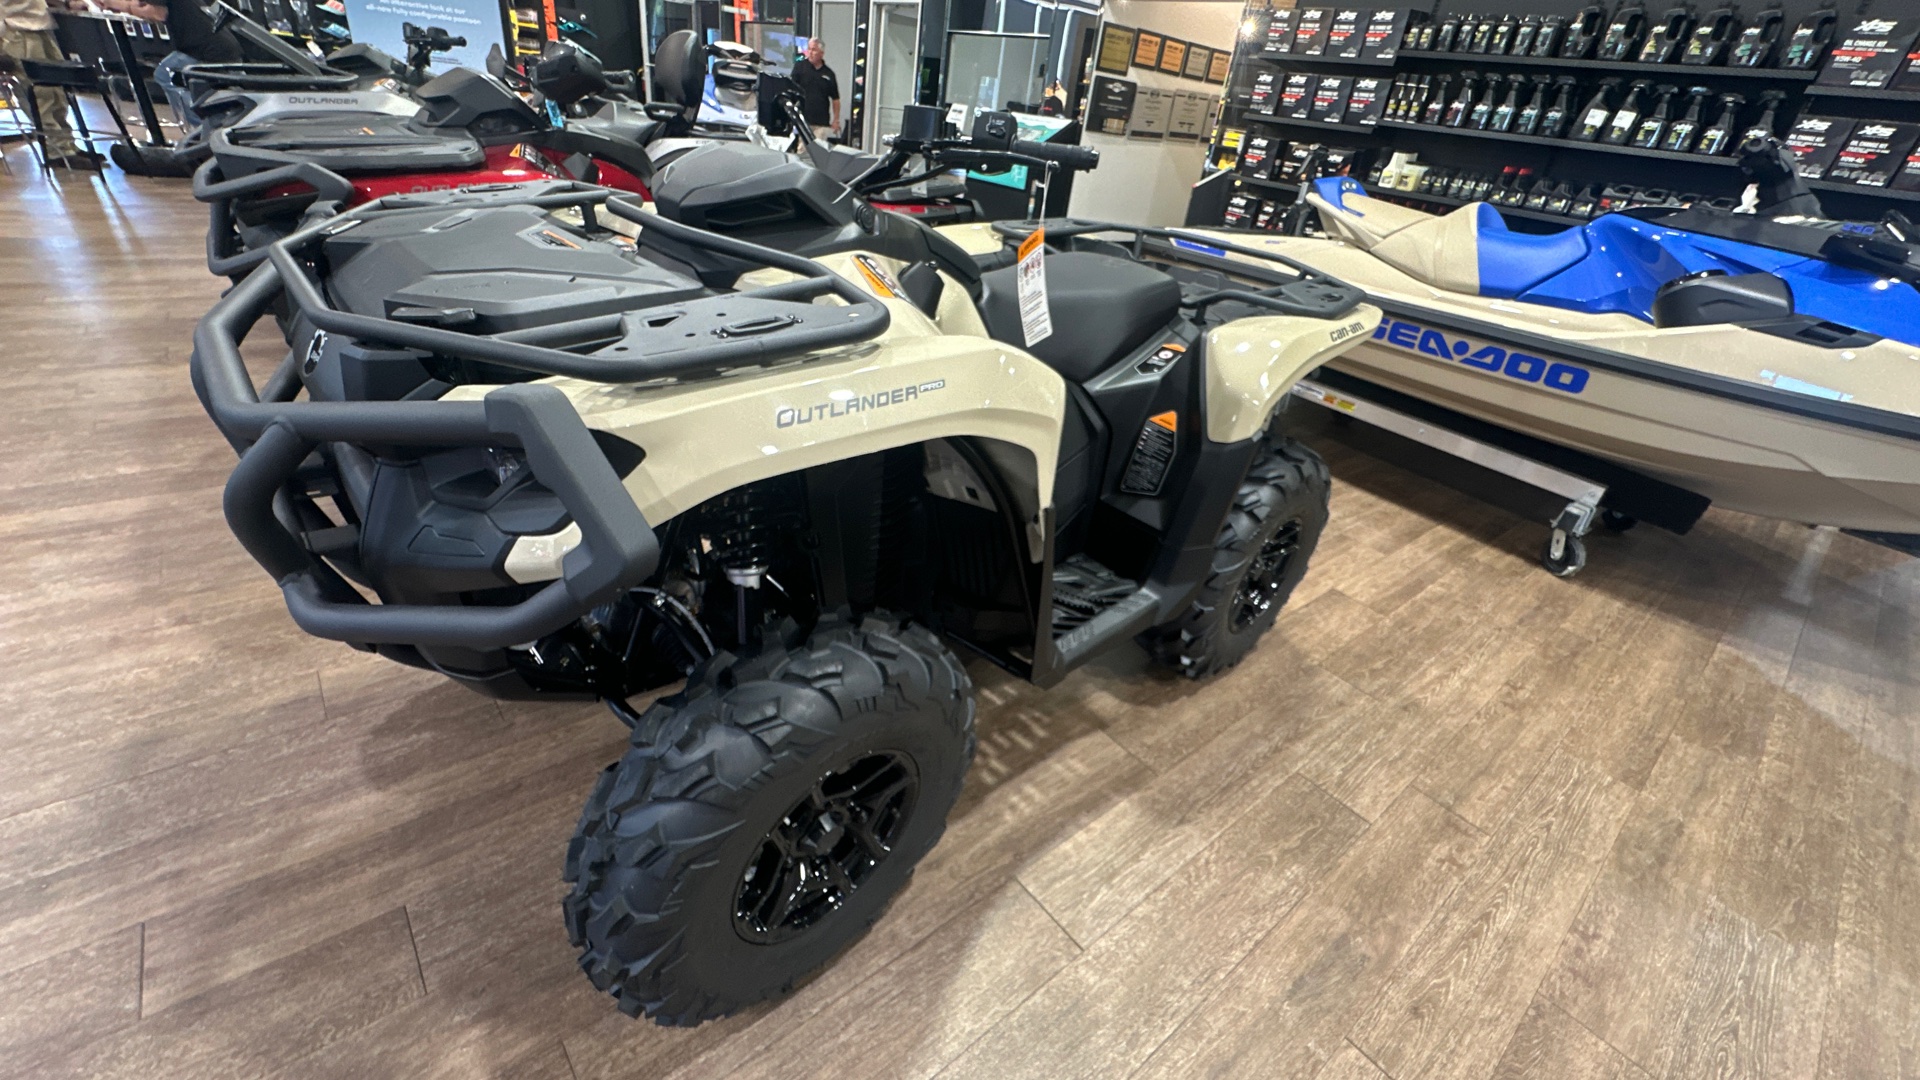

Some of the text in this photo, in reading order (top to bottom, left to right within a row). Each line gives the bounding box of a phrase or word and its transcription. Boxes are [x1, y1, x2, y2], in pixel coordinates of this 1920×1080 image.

[430, 3, 444, 12] look
[1853, 19, 1898, 33] XPS
[289, 96, 358, 105] OUTLANDER
[1795, 119, 1832, 132] XPS
[1857, 125, 1898, 138] XPS
[1330, 322, 1365, 342] can-am
[776, 380, 945, 429] OUTLANDER PRO
